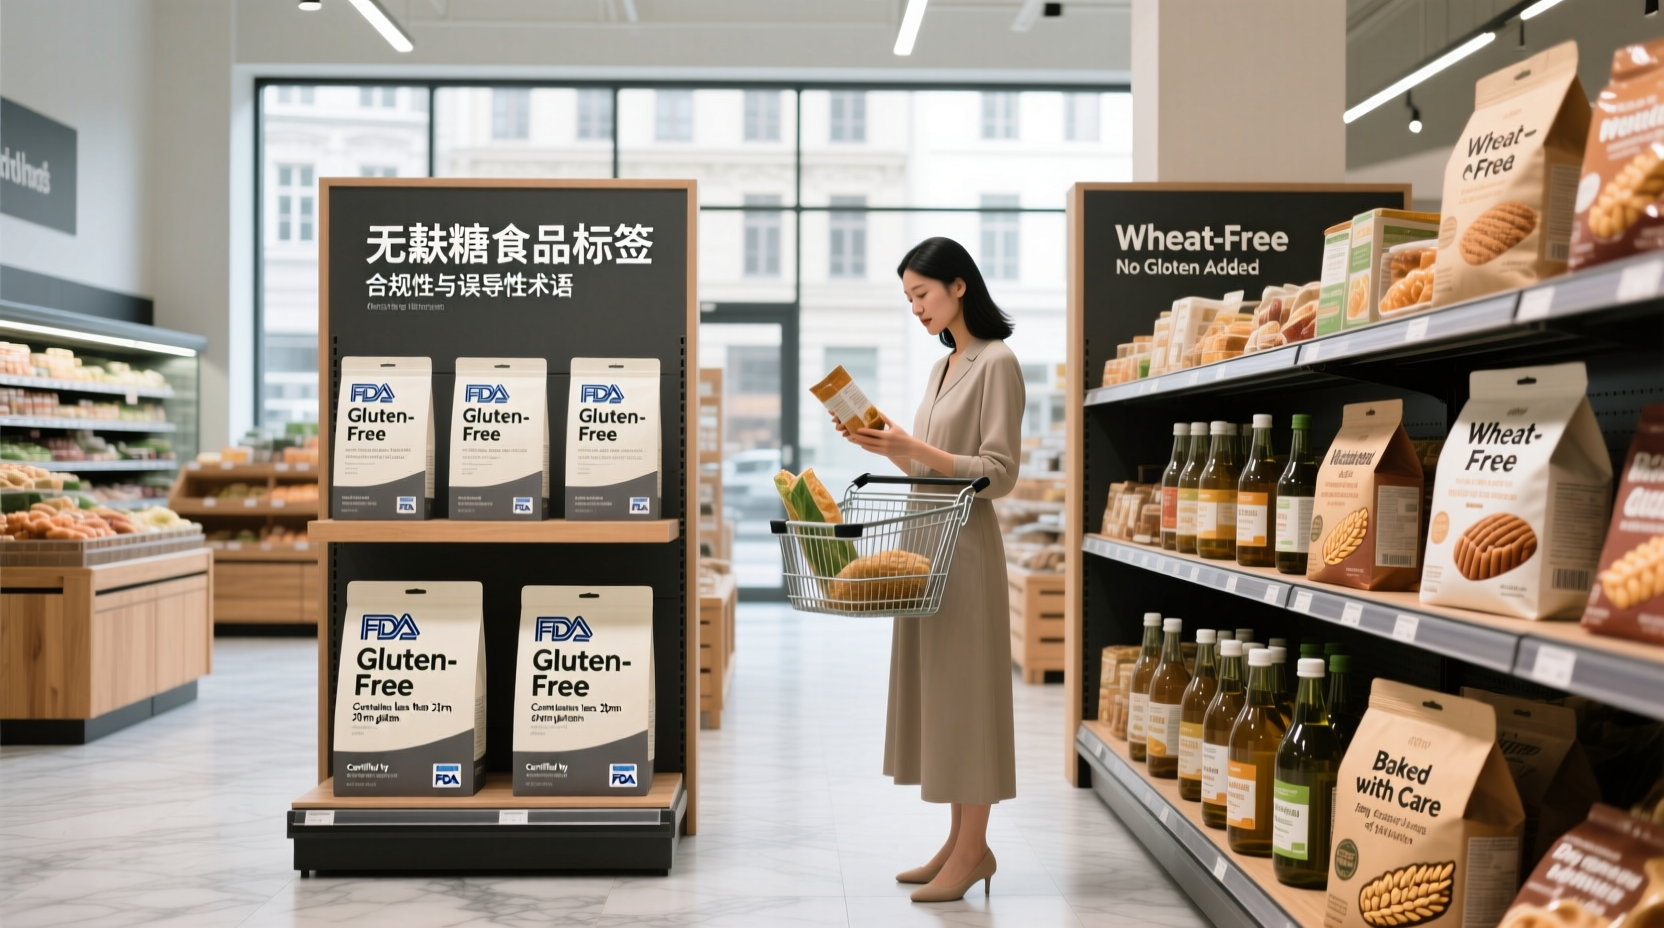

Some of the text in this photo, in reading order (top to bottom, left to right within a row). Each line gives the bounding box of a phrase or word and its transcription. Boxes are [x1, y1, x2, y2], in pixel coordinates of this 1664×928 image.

[1114, 222, 1289, 252] Wheat-Free
[1116, 258, 1260, 275] No Gloten Added
[366, 272, 573, 299] 合规性与误导性术语
[350, 383, 395, 403] FDA
[465, 383, 510, 404] FDA
[580, 383, 624, 404] FDA
[347, 407, 415, 424] Gluten-
[463, 407, 530, 424] Gluten-
[579, 407, 646, 424] Gluten-
[347, 426, 386, 441] Free
[463, 426, 501, 441] Free
[578, 427, 617, 442] Free
[1468, 421, 1543, 445] Wheat-
[1464, 448, 1518, 473] Free
[360, 613, 421, 641] FDA
[535, 615, 593, 642] FDA
[357, 647, 457, 671] Gluten-
[533, 649, 631, 671] Gluten-
[355, 674, 414, 696] Free
[532, 674, 590, 697] Free
[1372, 749, 1433, 785] Baked
[435, 773, 460, 785] FDA
[612, 774, 636, 785] FDA
[1356, 775, 1441, 817] with Care
